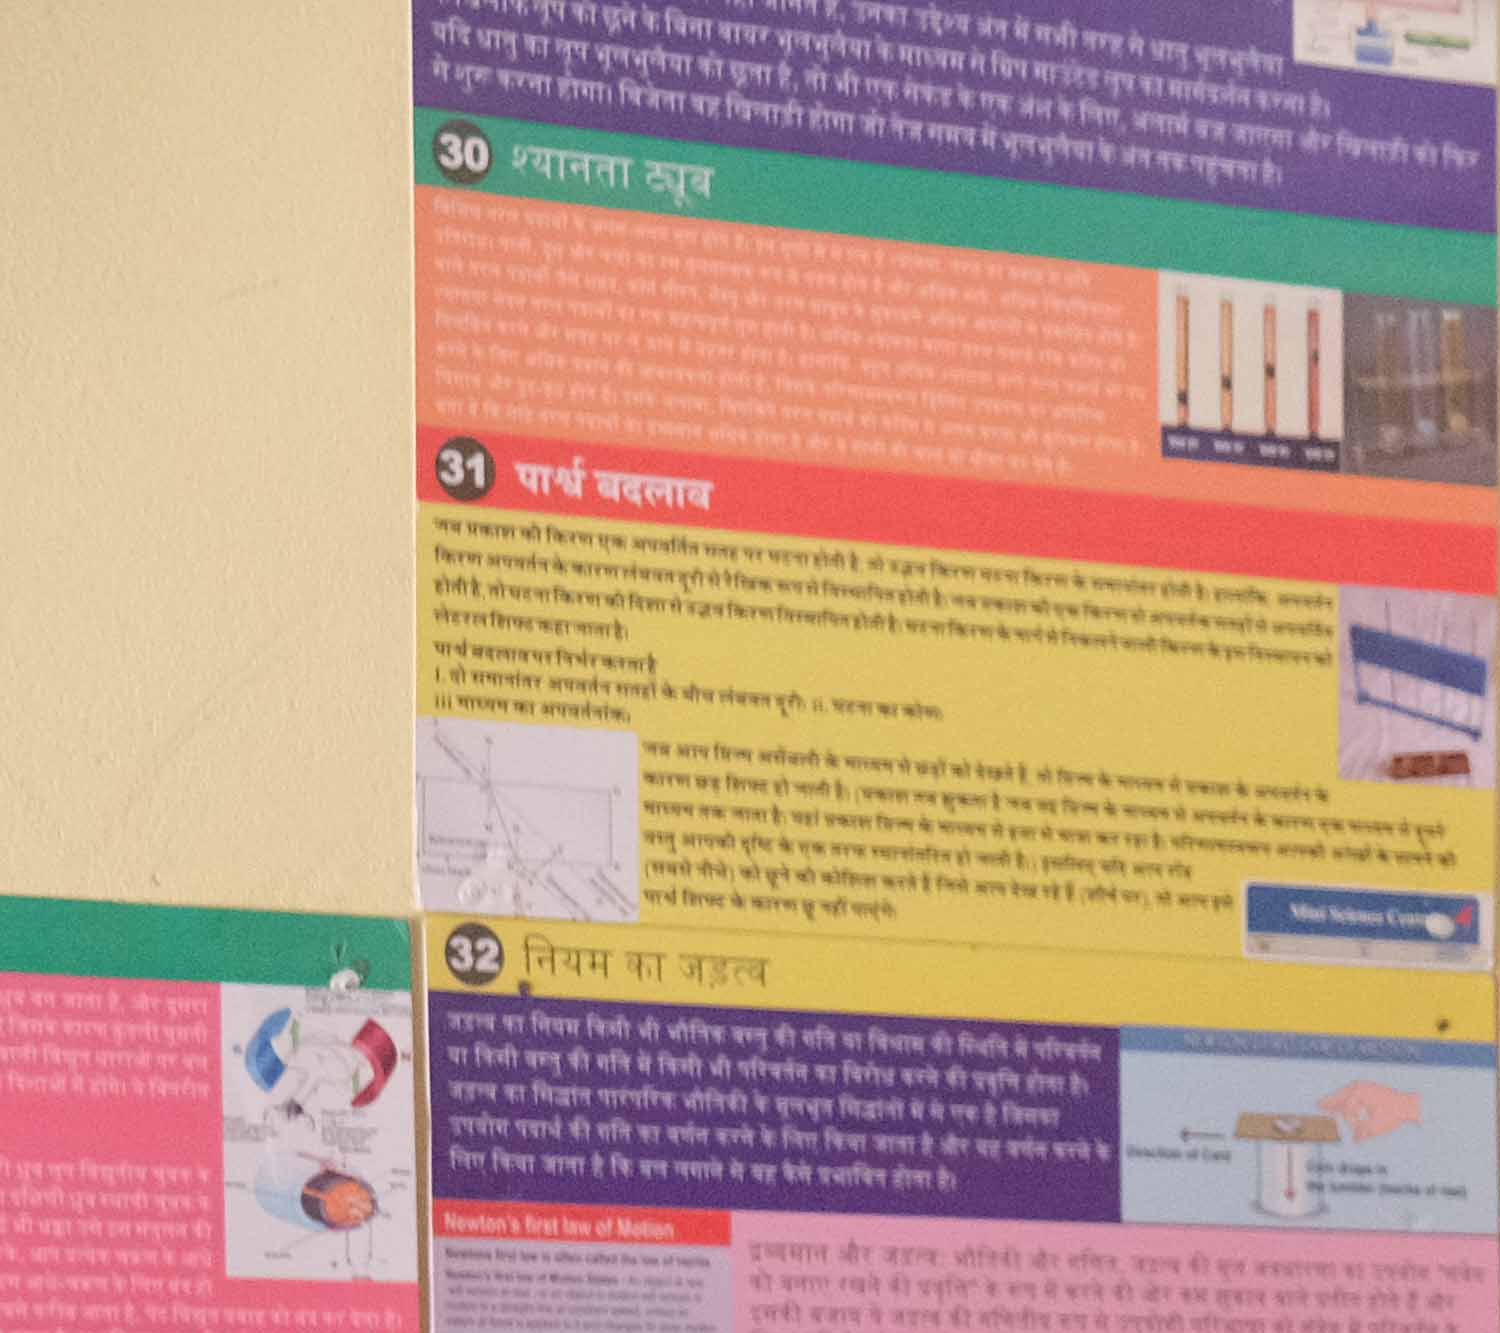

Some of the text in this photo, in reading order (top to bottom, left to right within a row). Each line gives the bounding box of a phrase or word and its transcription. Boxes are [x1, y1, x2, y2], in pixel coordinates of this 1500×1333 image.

[438, 131, 489, 173] 30
[511, 141, 633, 188] श्यानता
[437, 450, 488, 492] 31
[596, 470, 713, 515] बदलाव
[448, 936, 769, 988] 32 नियम का जड़त्व
[443, 1213, 520, 1235] Newton's
